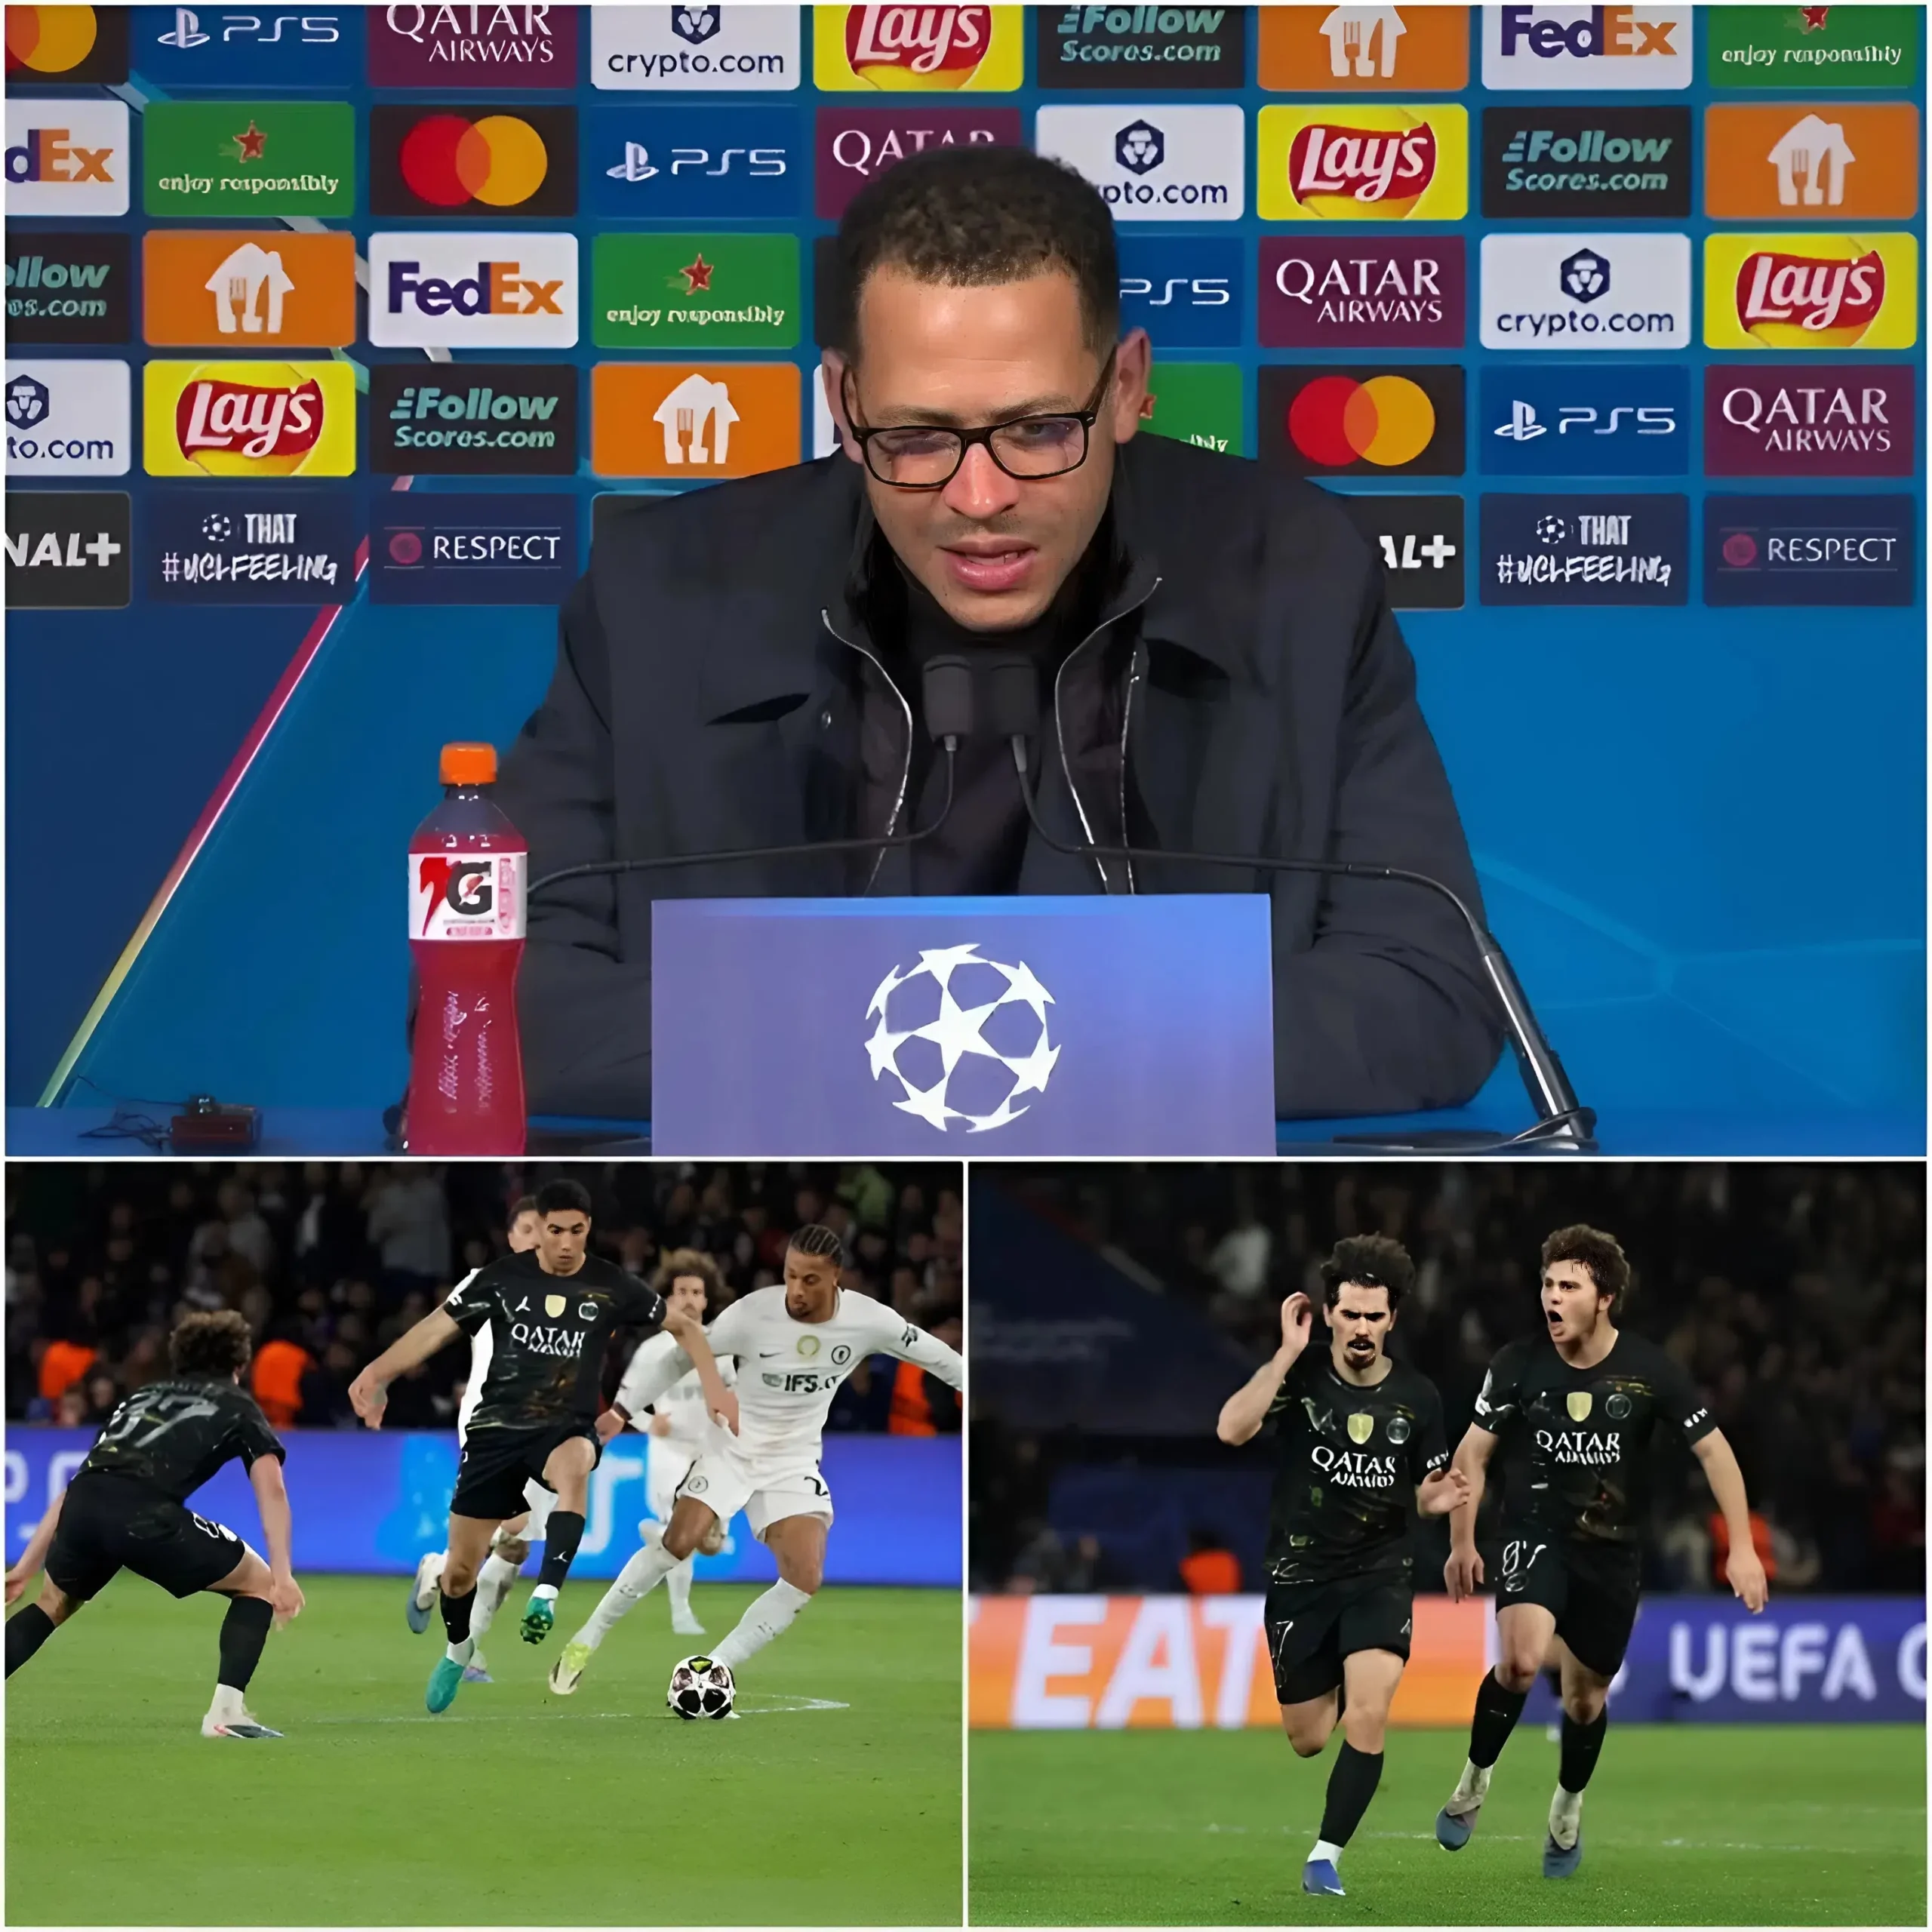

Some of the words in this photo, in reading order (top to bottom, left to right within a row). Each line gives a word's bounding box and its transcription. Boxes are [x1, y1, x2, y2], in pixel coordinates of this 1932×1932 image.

[223, 16, 339, 42] PS5
[386, 5, 552, 43] QATAR
[1082, 5, 1226, 33] Follow
[1501, 5, 1678, 57] FedEx
[429, 36, 554, 63] AIRWAYS
[1721, 44, 1777, 66] enjoy
[608, 51, 784, 77] crypto.com
[1527, 130, 1673, 163] Follow
[672, 149, 786, 176] PS5
[1297, 128, 1428, 202] Lay's
[158, 174, 214, 193] enjoy
[1506, 168, 1669, 191] Scores.com
[388, 261, 565, 316] FedEx
[1119, 278, 1230, 306] PS5
[1275, 259, 1441, 304] QATAR
[1745, 256, 1877, 331] Lay's
[606, 305, 661, 326] enjoy
[1317, 300, 1443, 323] AIRWAYS
[1497, 310, 1675, 337] crypto.com
[415, 387, 559, 420] Follow
[1722, 387, 1890, 433] QATAR
[184, 383, 316, 458] Lay's
[1558, 407, 1676, 435] PS5
[1764, 429, 1891, 452] AIRWAYS
[244, 514, 297, 543] THAT
[1578, 515, 1632, 545] THAT
[433, 535, 561, 561] RESPECT
[1767, 537, 1897, 562] RESPECT
[162, 552, 338, 586] #UCLFEELING
[1495, 554, 1672, 587] #UCLFEELING
[1009, 1594, 1265, 1730] EAT
[1669, 1621, 1877, 1703] UEFA
